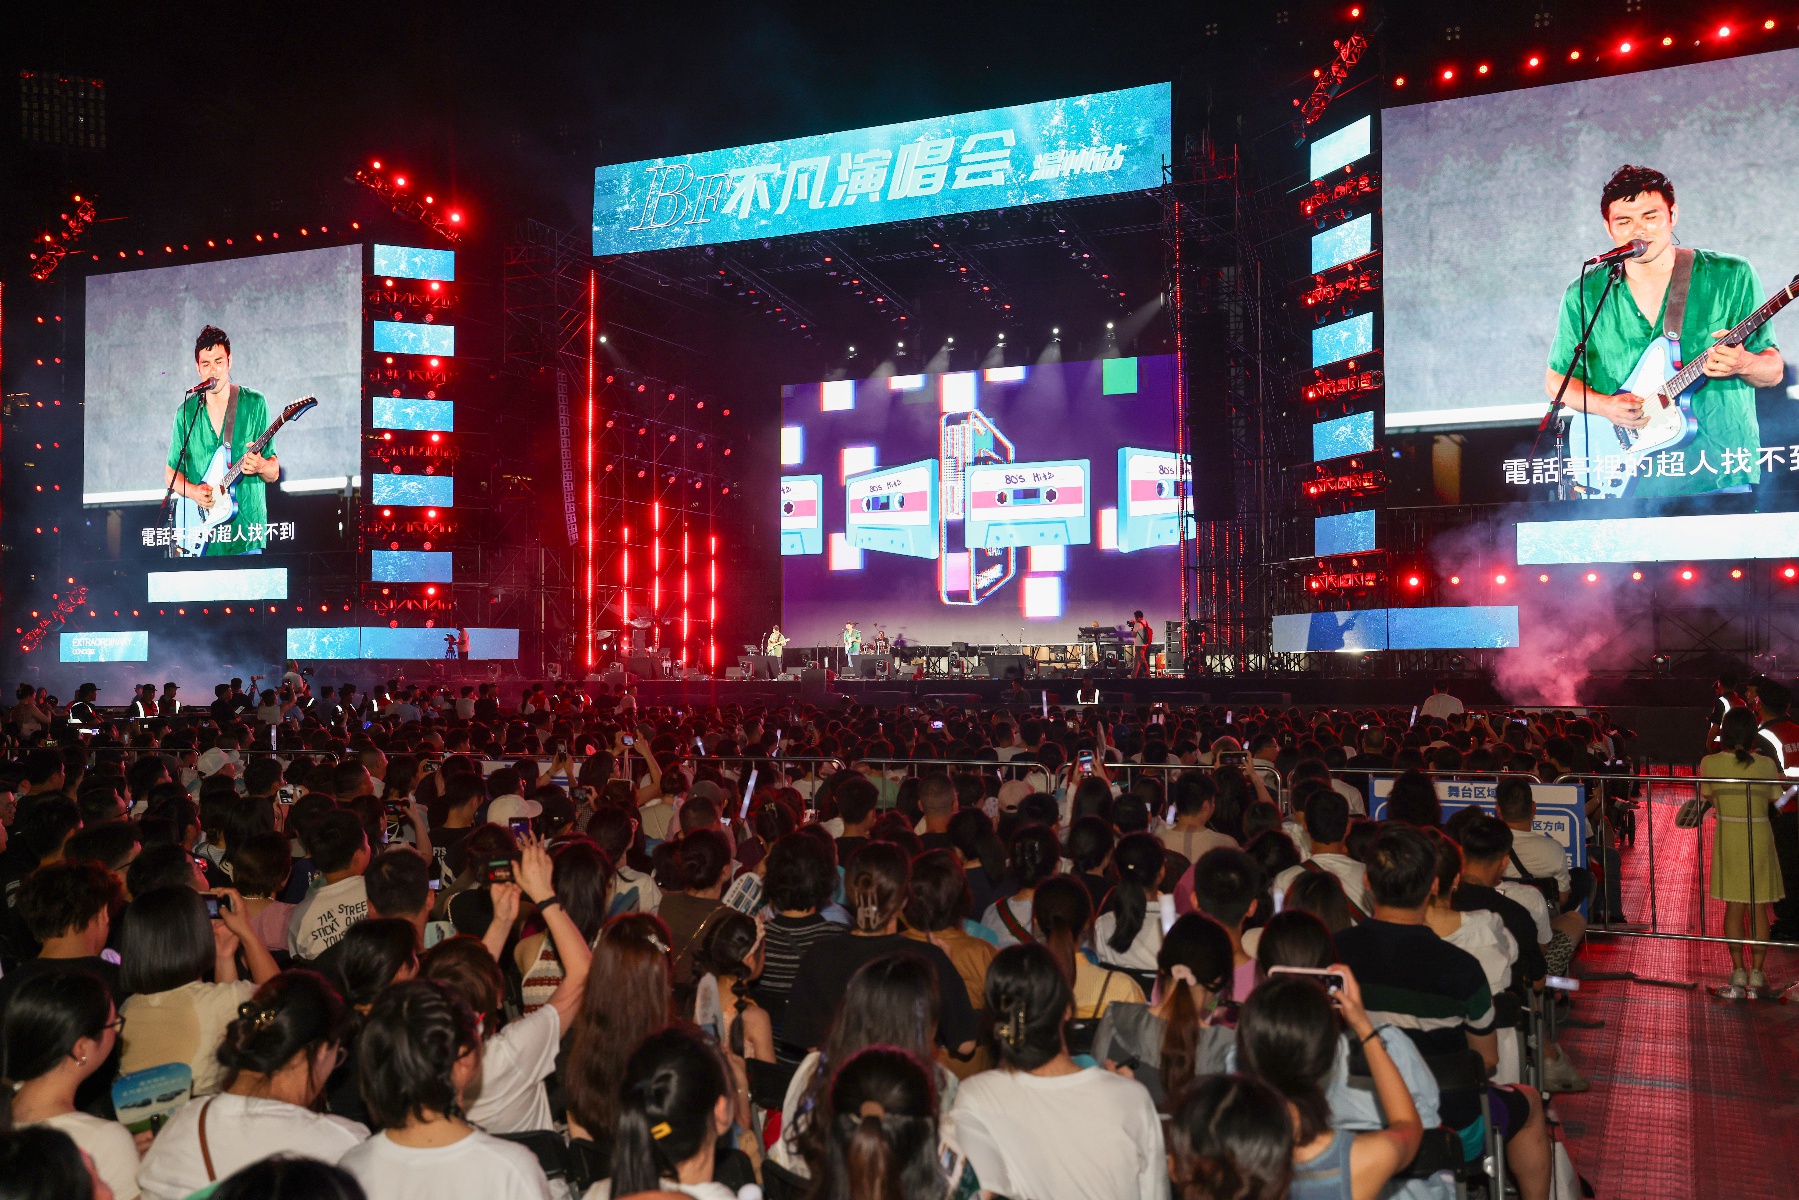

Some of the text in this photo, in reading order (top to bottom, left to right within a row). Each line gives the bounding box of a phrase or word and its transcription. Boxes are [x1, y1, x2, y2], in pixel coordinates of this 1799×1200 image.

[720, 129, 1016, 219] 不凡演唱会
[1004, 474, 1026, 485] 80's
[141, 521, 295, 547] 電話亭裡的超人找不到
[72, 636, 132, 648] EXTRAORDINARY
